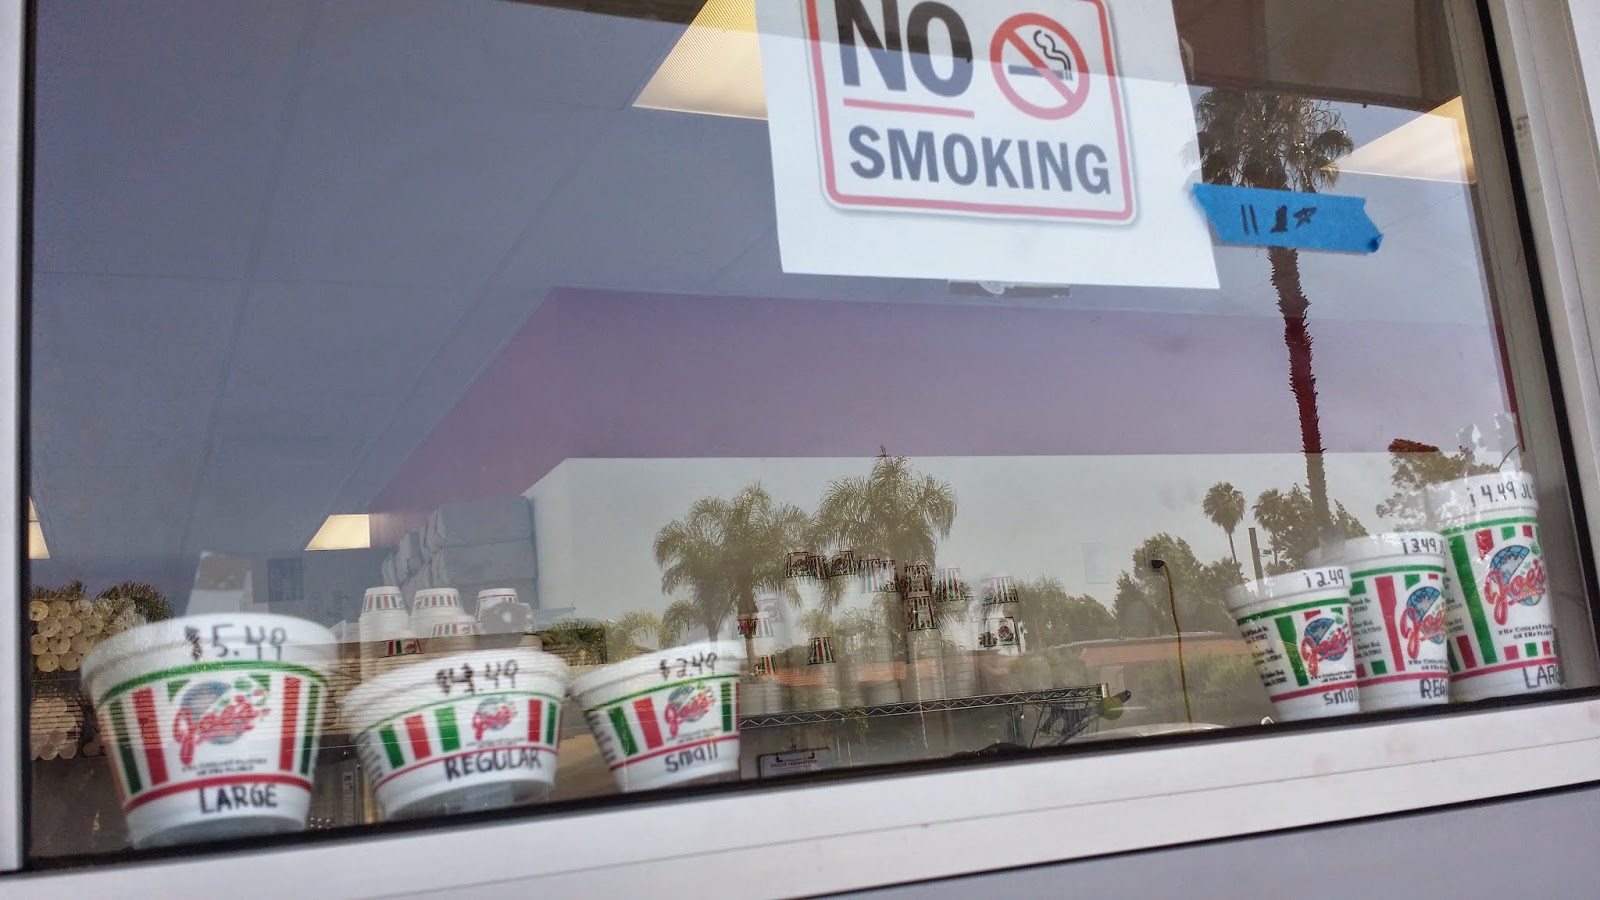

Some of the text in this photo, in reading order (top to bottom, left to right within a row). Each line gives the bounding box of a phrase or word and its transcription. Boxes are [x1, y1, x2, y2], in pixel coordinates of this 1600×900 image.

[834, 0, 974, 98] NO
[848, 124, 1111, 195] SMOKING
[444, 747, 543, 782] REGULAR
[199, 783, 279, 814] LARGE
